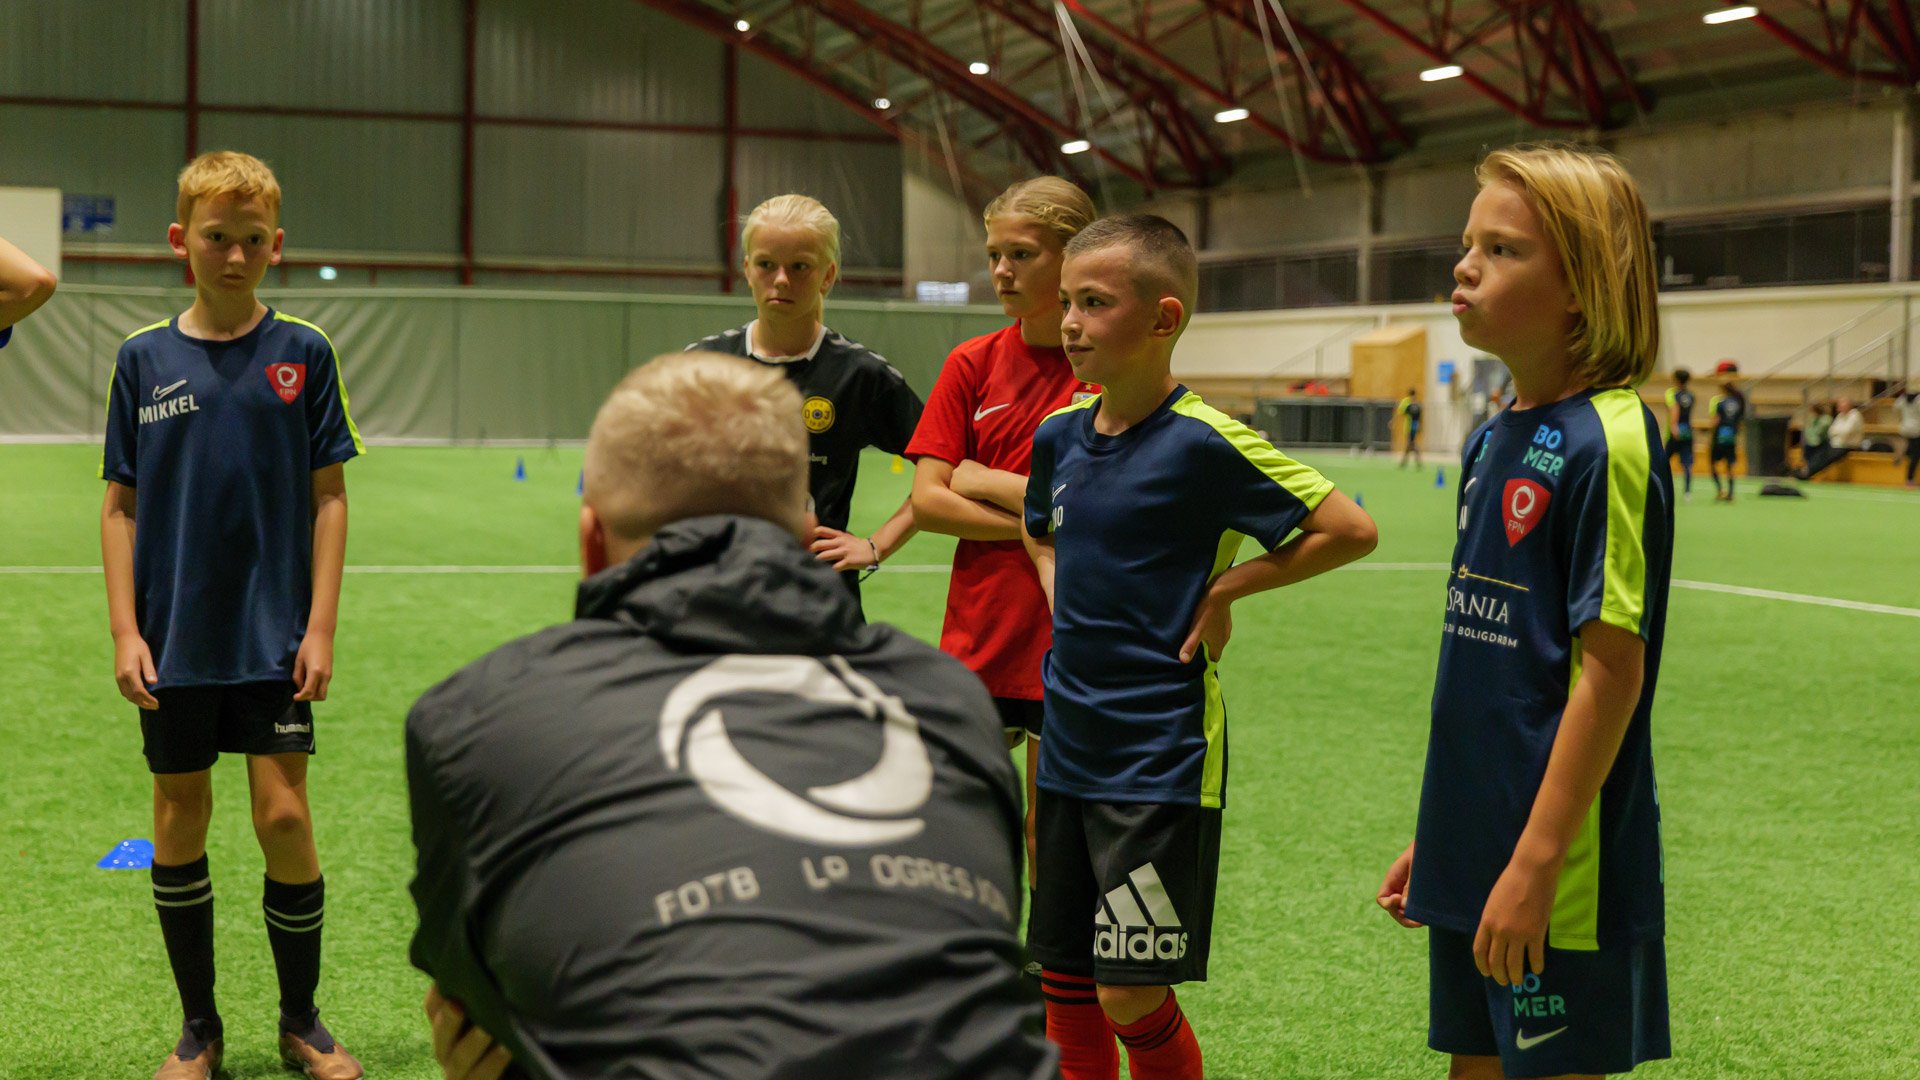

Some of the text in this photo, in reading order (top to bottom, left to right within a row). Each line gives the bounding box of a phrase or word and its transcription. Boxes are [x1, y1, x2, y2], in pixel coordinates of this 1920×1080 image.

[279, 387, 297, 396] FPN
[138, 394, 200, 424] MIKKEL
[1533, 424, 1562, 449] BO
[1522, 446, 1565, 477] MER
[1507, 519, 1526, 534] FPN
[1446, 586, 1509, 624] SPANIA
[1513, 994, 1566, 1017] MER
